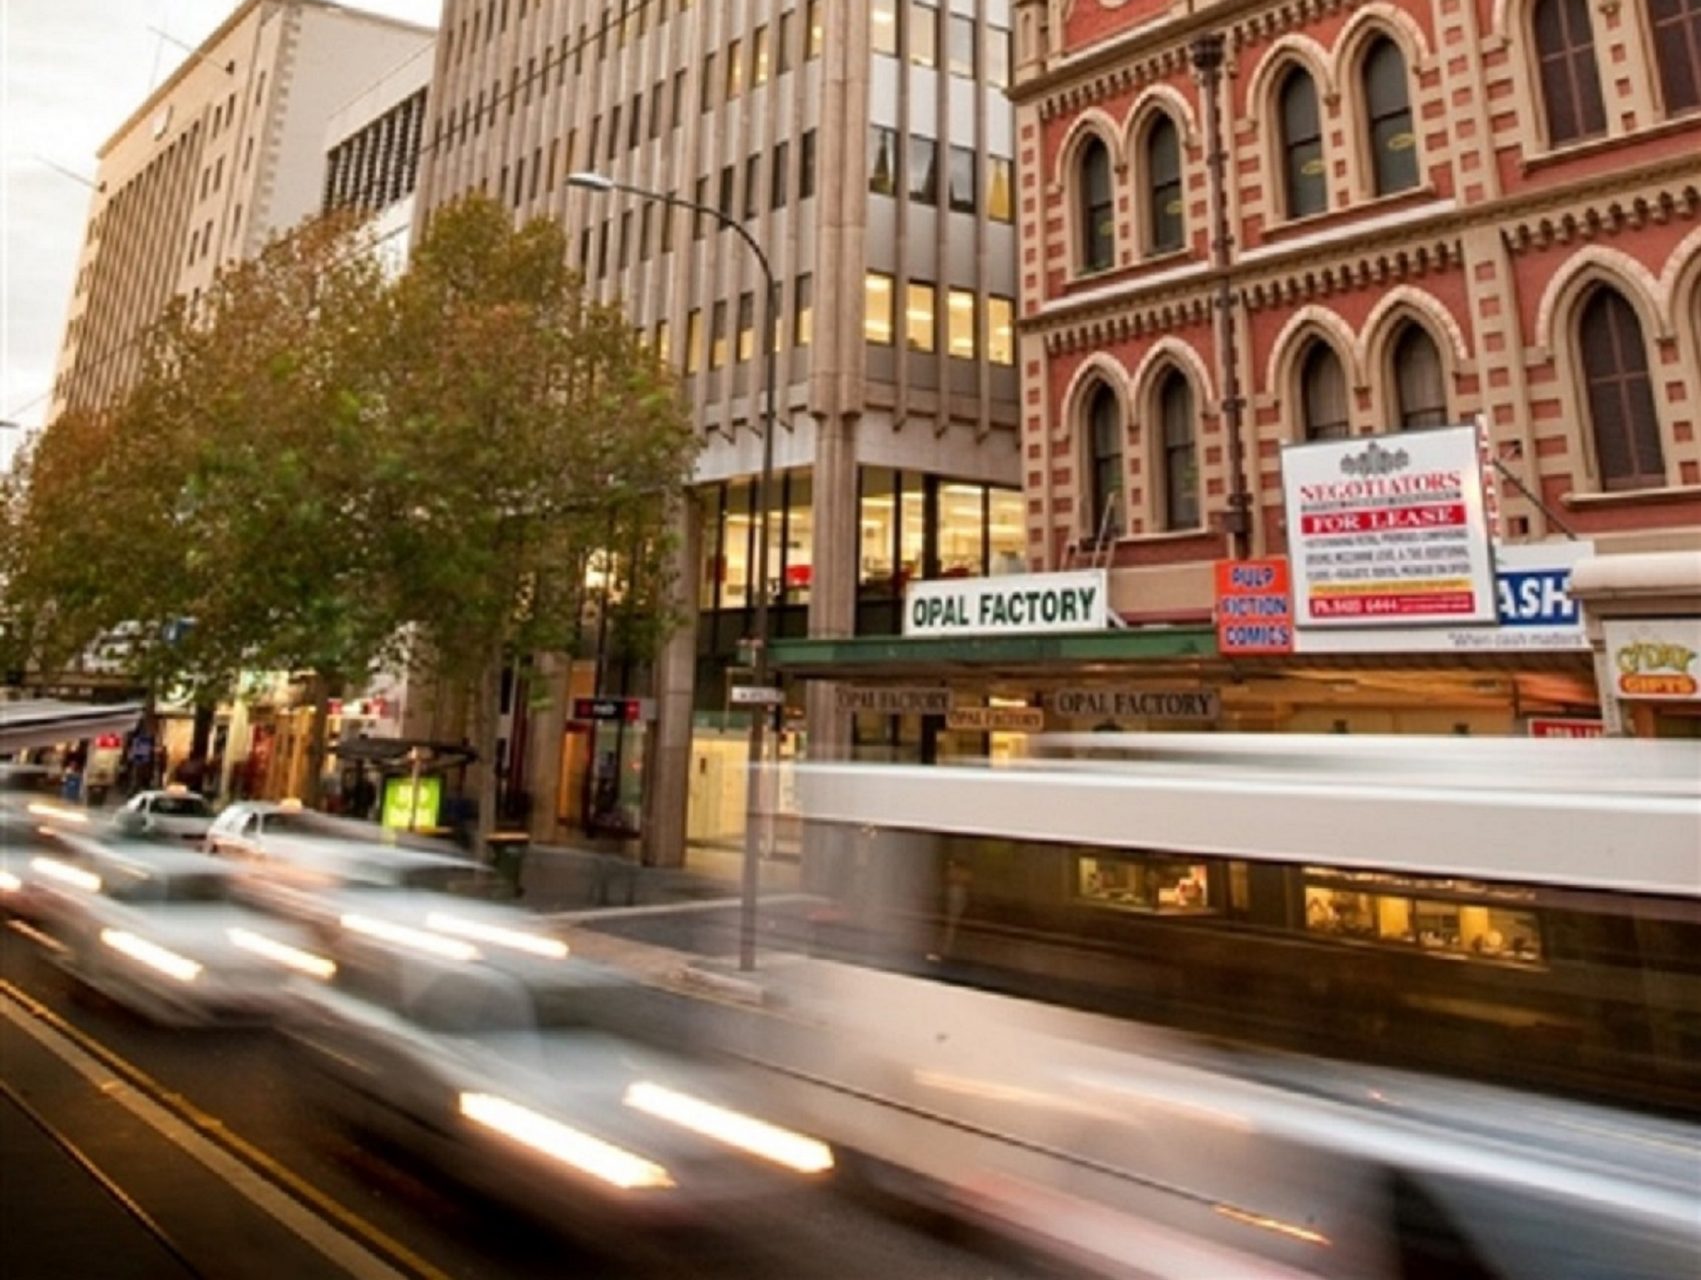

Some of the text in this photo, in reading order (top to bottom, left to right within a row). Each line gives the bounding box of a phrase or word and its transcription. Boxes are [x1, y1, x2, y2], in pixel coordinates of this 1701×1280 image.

[1301, 472, 1461, 500] NEGOTIATORS
[1313, 507, 1455, 533] FOR LEASE
[1232, 567, 1274, 587] PULP
[912, 587, 1096, 627] OPAL FACTORY
[1222, 597, 1287, 616] FICTION
[1225, 624, 1289, 646] COMICS
[838, 691, 948, 709] OPAL FACTORY
[1058, 692, 1213, 716] OPAL FACTORY
